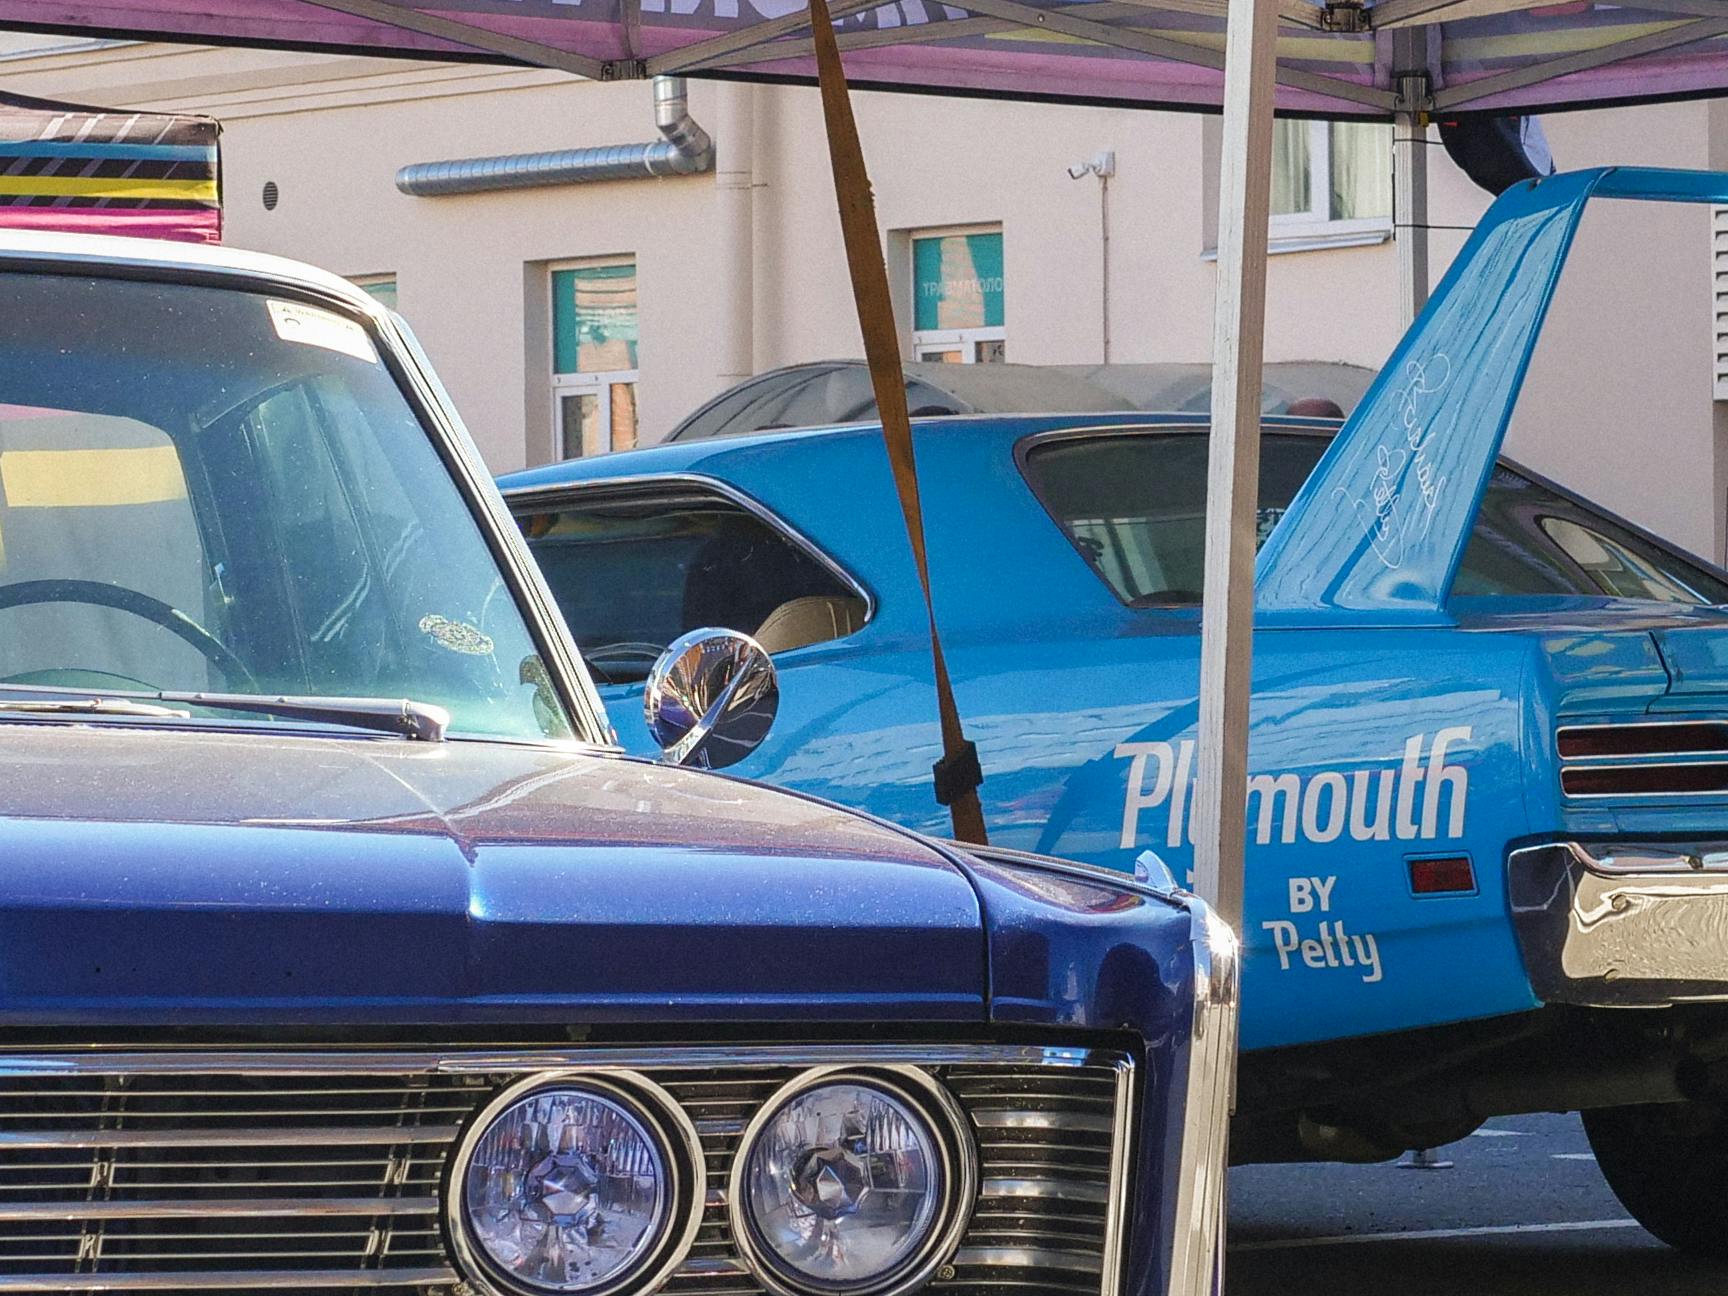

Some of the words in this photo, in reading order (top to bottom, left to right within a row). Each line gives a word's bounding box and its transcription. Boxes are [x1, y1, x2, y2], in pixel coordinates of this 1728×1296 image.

[1113, 726, 1472, 884] Plmouth
[1288, 876, 1337, 913] BY
[1262, 919, 1383, 983] Petty
